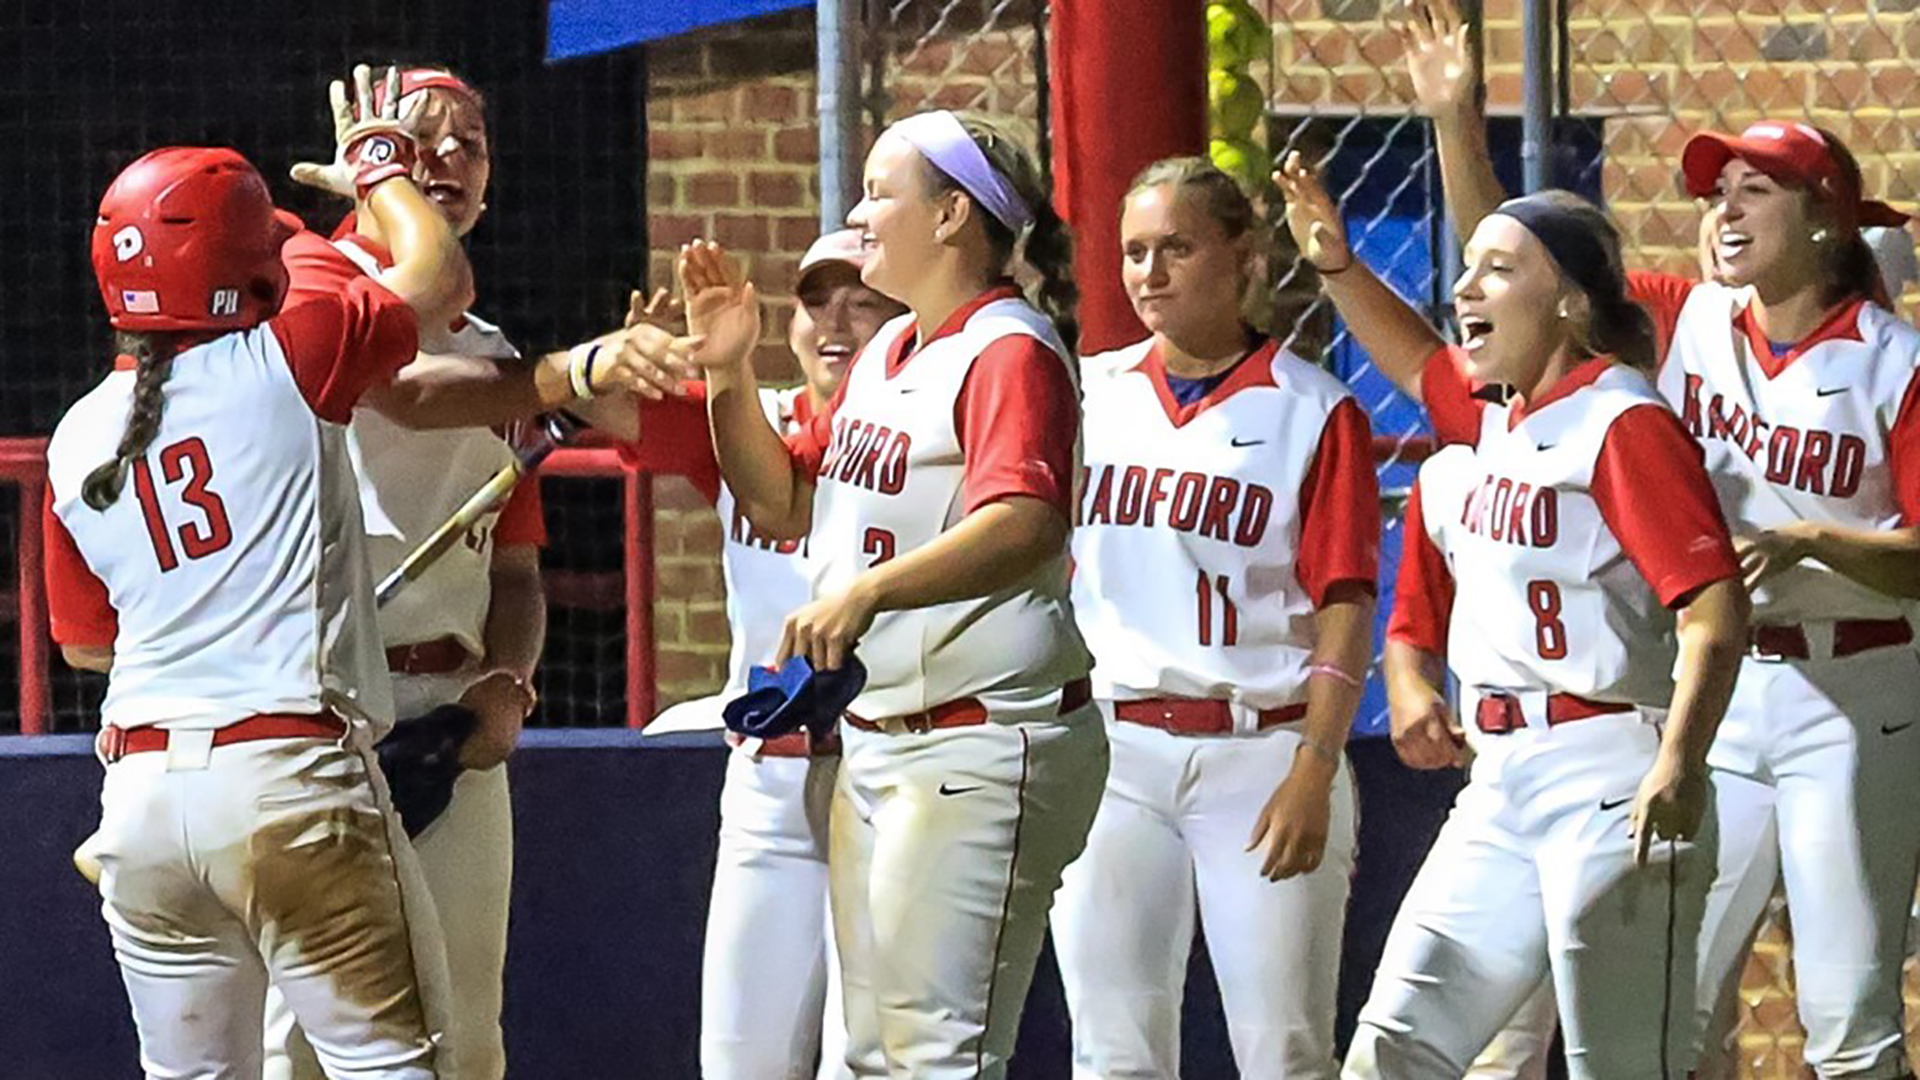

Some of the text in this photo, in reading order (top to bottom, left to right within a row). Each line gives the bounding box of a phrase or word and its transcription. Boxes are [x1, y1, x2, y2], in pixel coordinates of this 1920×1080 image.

[132, 435, 234, 574] 13
[1196, 567, 1238, 647] 11
[1526, 579, 1568, 661] 8
